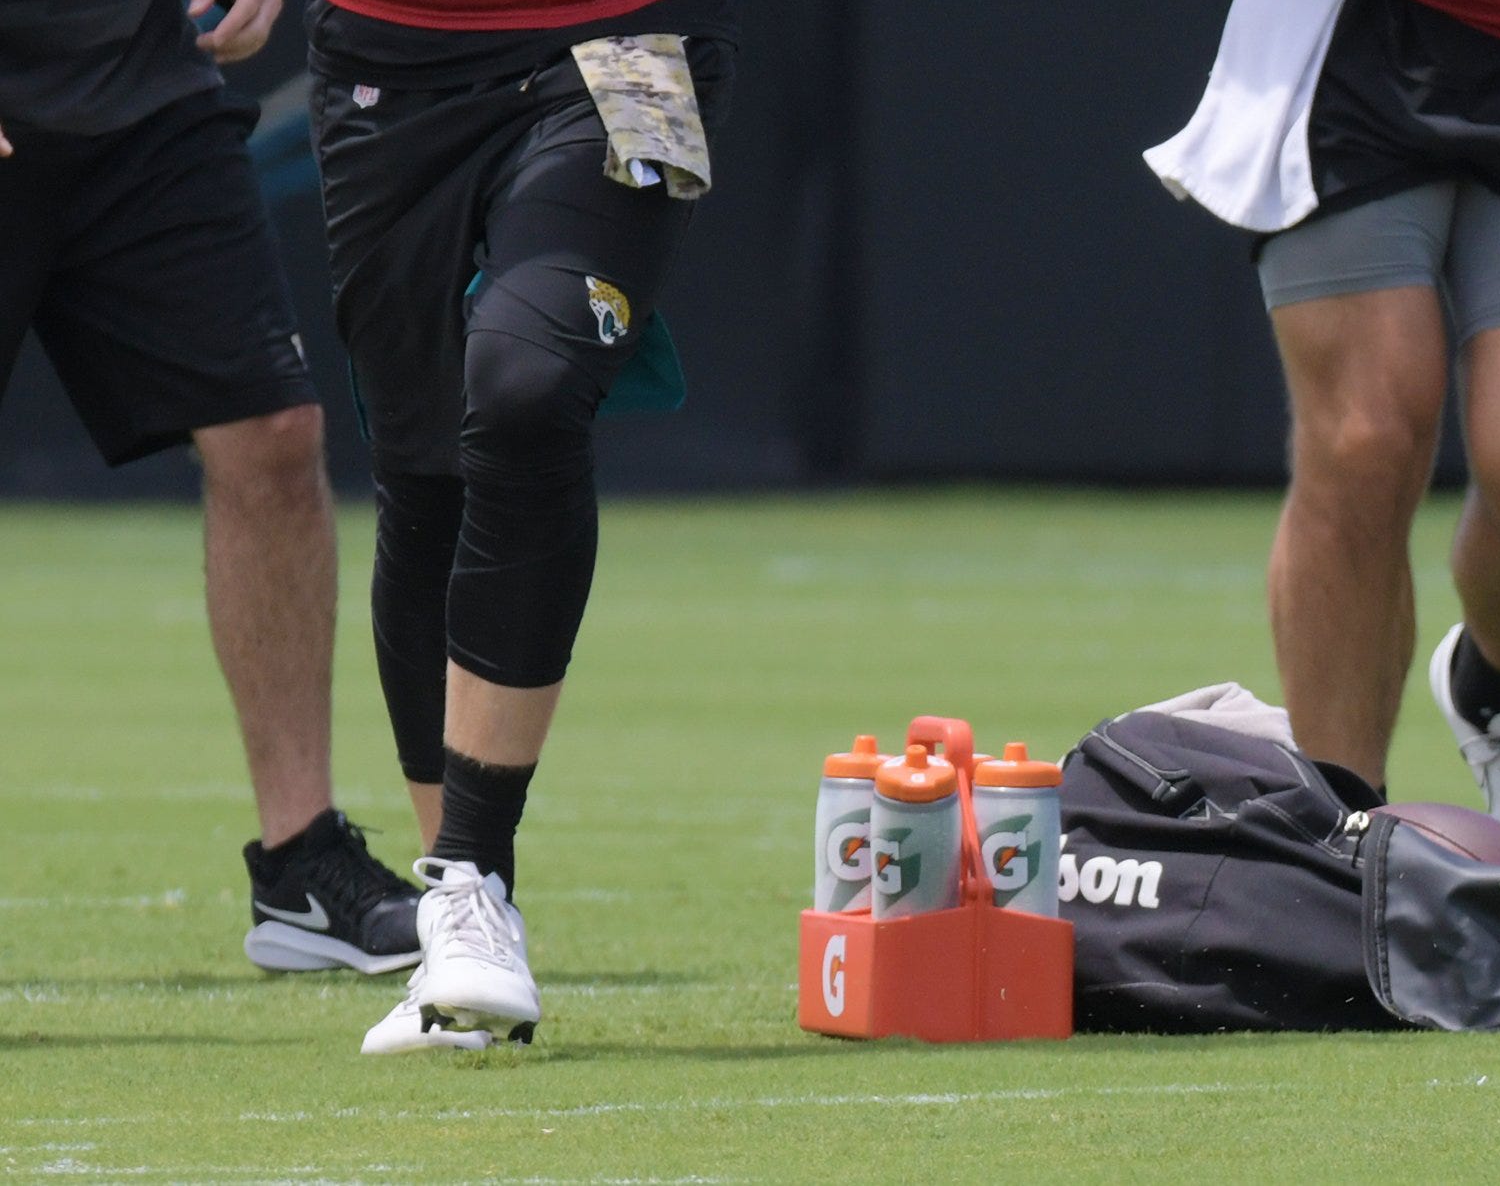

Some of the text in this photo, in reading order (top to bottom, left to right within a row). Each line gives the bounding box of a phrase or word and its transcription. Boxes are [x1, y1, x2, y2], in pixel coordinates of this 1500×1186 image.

[871, 837, 902, 895] G
[982, 830, 1029, 891] G
[822, 934, 847, 1018] G
